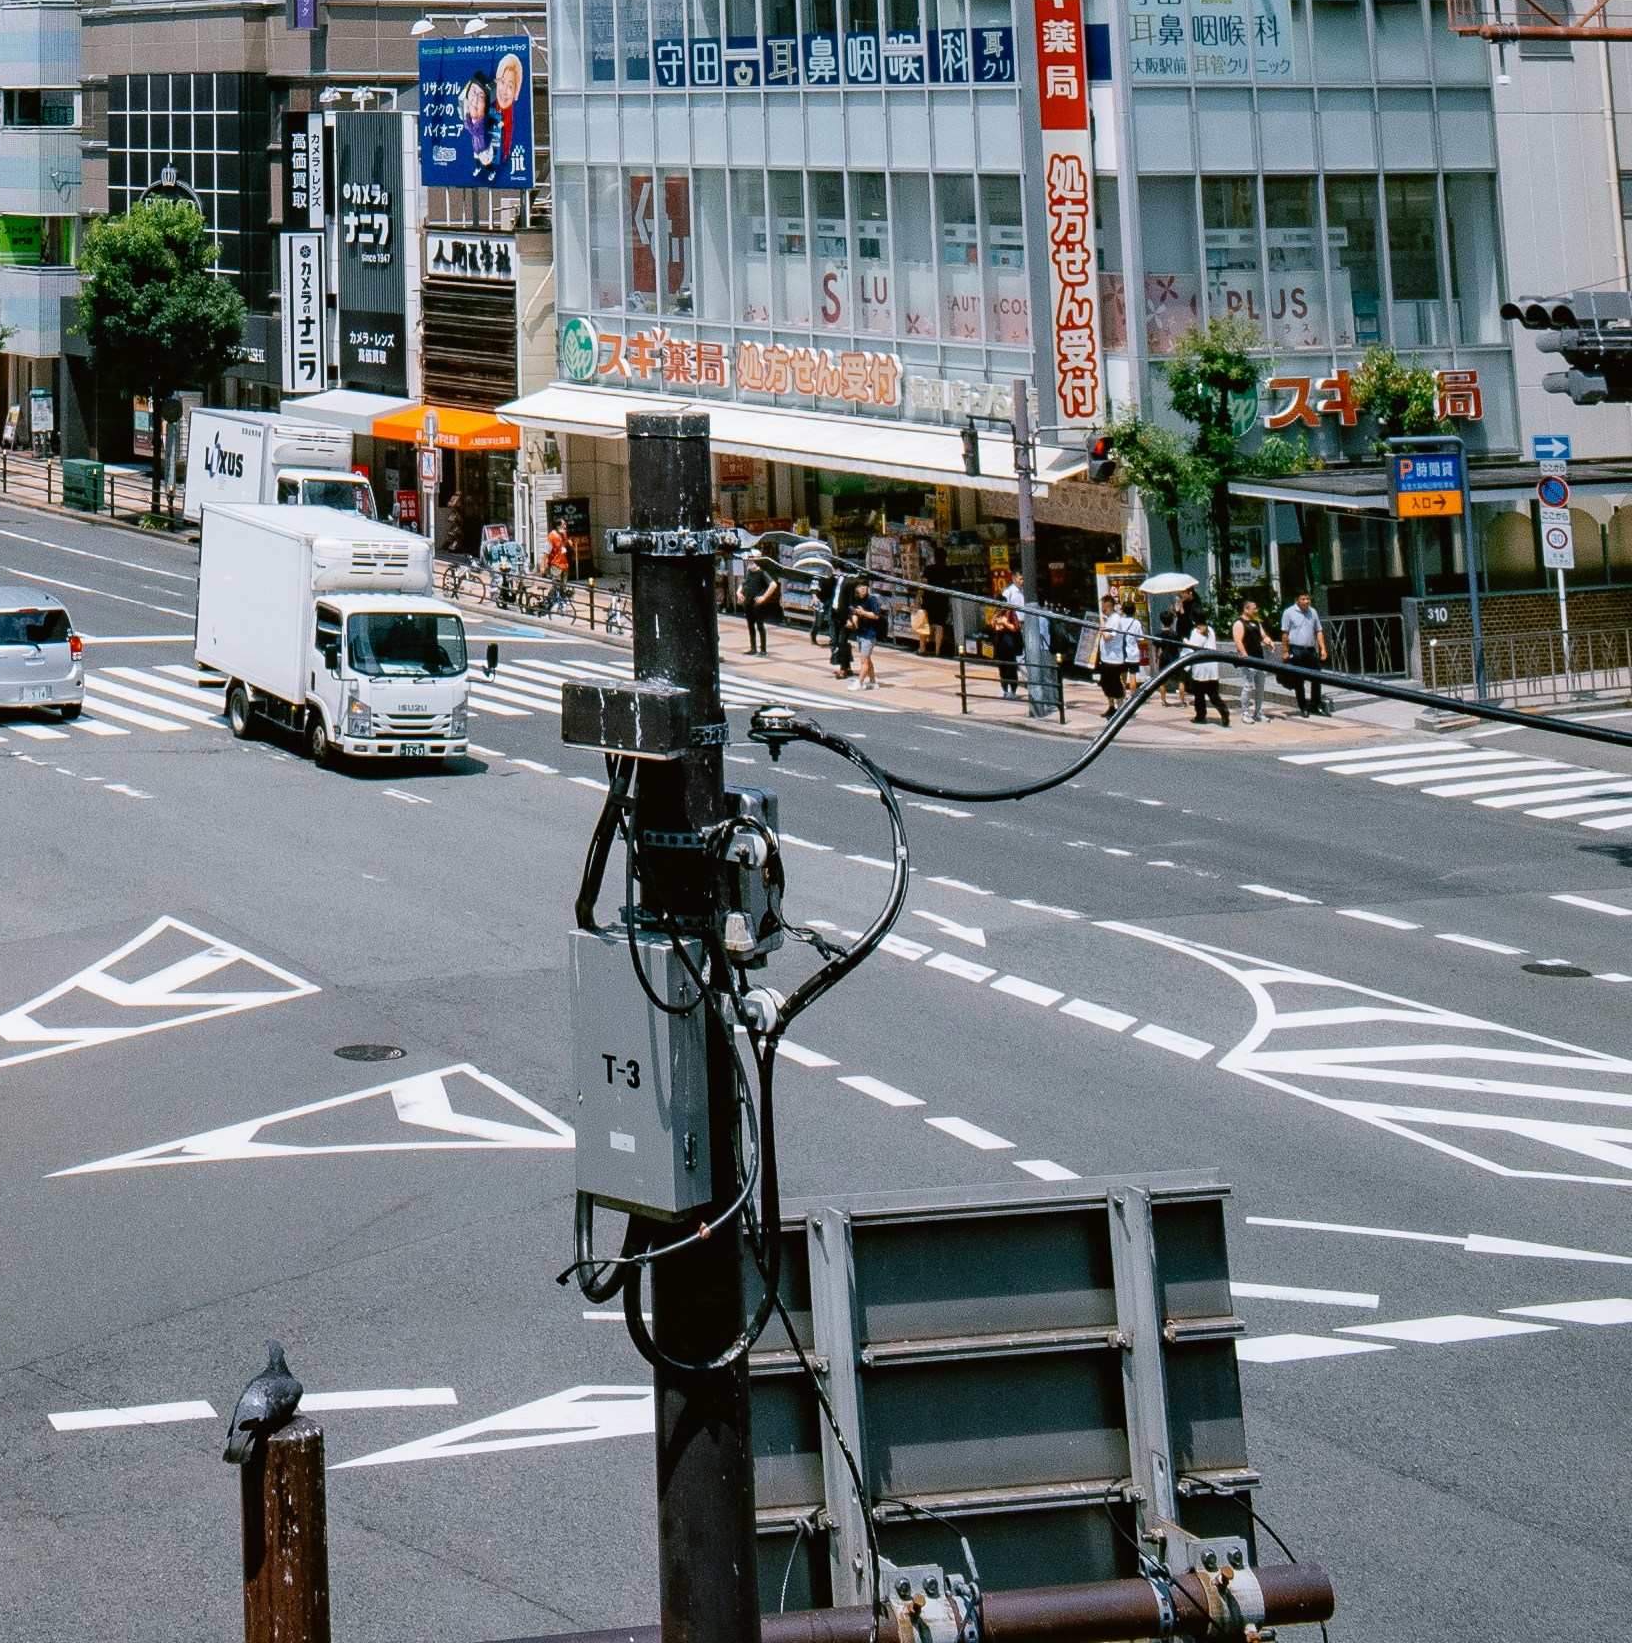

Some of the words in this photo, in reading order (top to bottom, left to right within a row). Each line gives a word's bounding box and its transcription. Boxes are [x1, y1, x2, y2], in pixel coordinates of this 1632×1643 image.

[1130, 14, 1280, 48] 耳鼻咽喉科
[657, 41, 719, 86] 守田
[767, 30, 969, 85] 耳鼻咽喉科
[1130, 55, 1188, 77] 大阪駅前
[1195, 54, 1292, 76] 耳管クリニック
[422, 81, 461, 96] リサイクル
[423, 103, 455, 117] インクの
[423, 123, 464, 138] パイオニア
[291, 132, 307, 209] 高価買取
[310, 133, 322, 208] カメラ・レンズ
[510, 151, 526, 175] jit
[351, 183, 388, 205] カメラの
[343, 211, 390, 245] ナニワ
[361, 252, 377, 263] since
[1047, 153, 1099, 419] 処方せん受付
[298, 261, 317, 382] カメラのナニワ
[349, 331, 395, 347] カメラ・レンズ
[358, 347, 387, 365] 高価買取
[598, 327, 726, 387] スギ薬局
[736, 342, 899, 406] 処方せん受付
[1416, 461, 1453, 478] 時間貸
[1541, 465, 1567, 473] ここから
[1412, 497, 1431, 509] 入口
[1541, 510, 1569, 521] ここから
[1551, 532, 1564, 545] 30
[1427, 607, 1448, 623] 310
[398, 704, 428, 712] ISUZU
[601, 1052, 641, 1090] T-3
